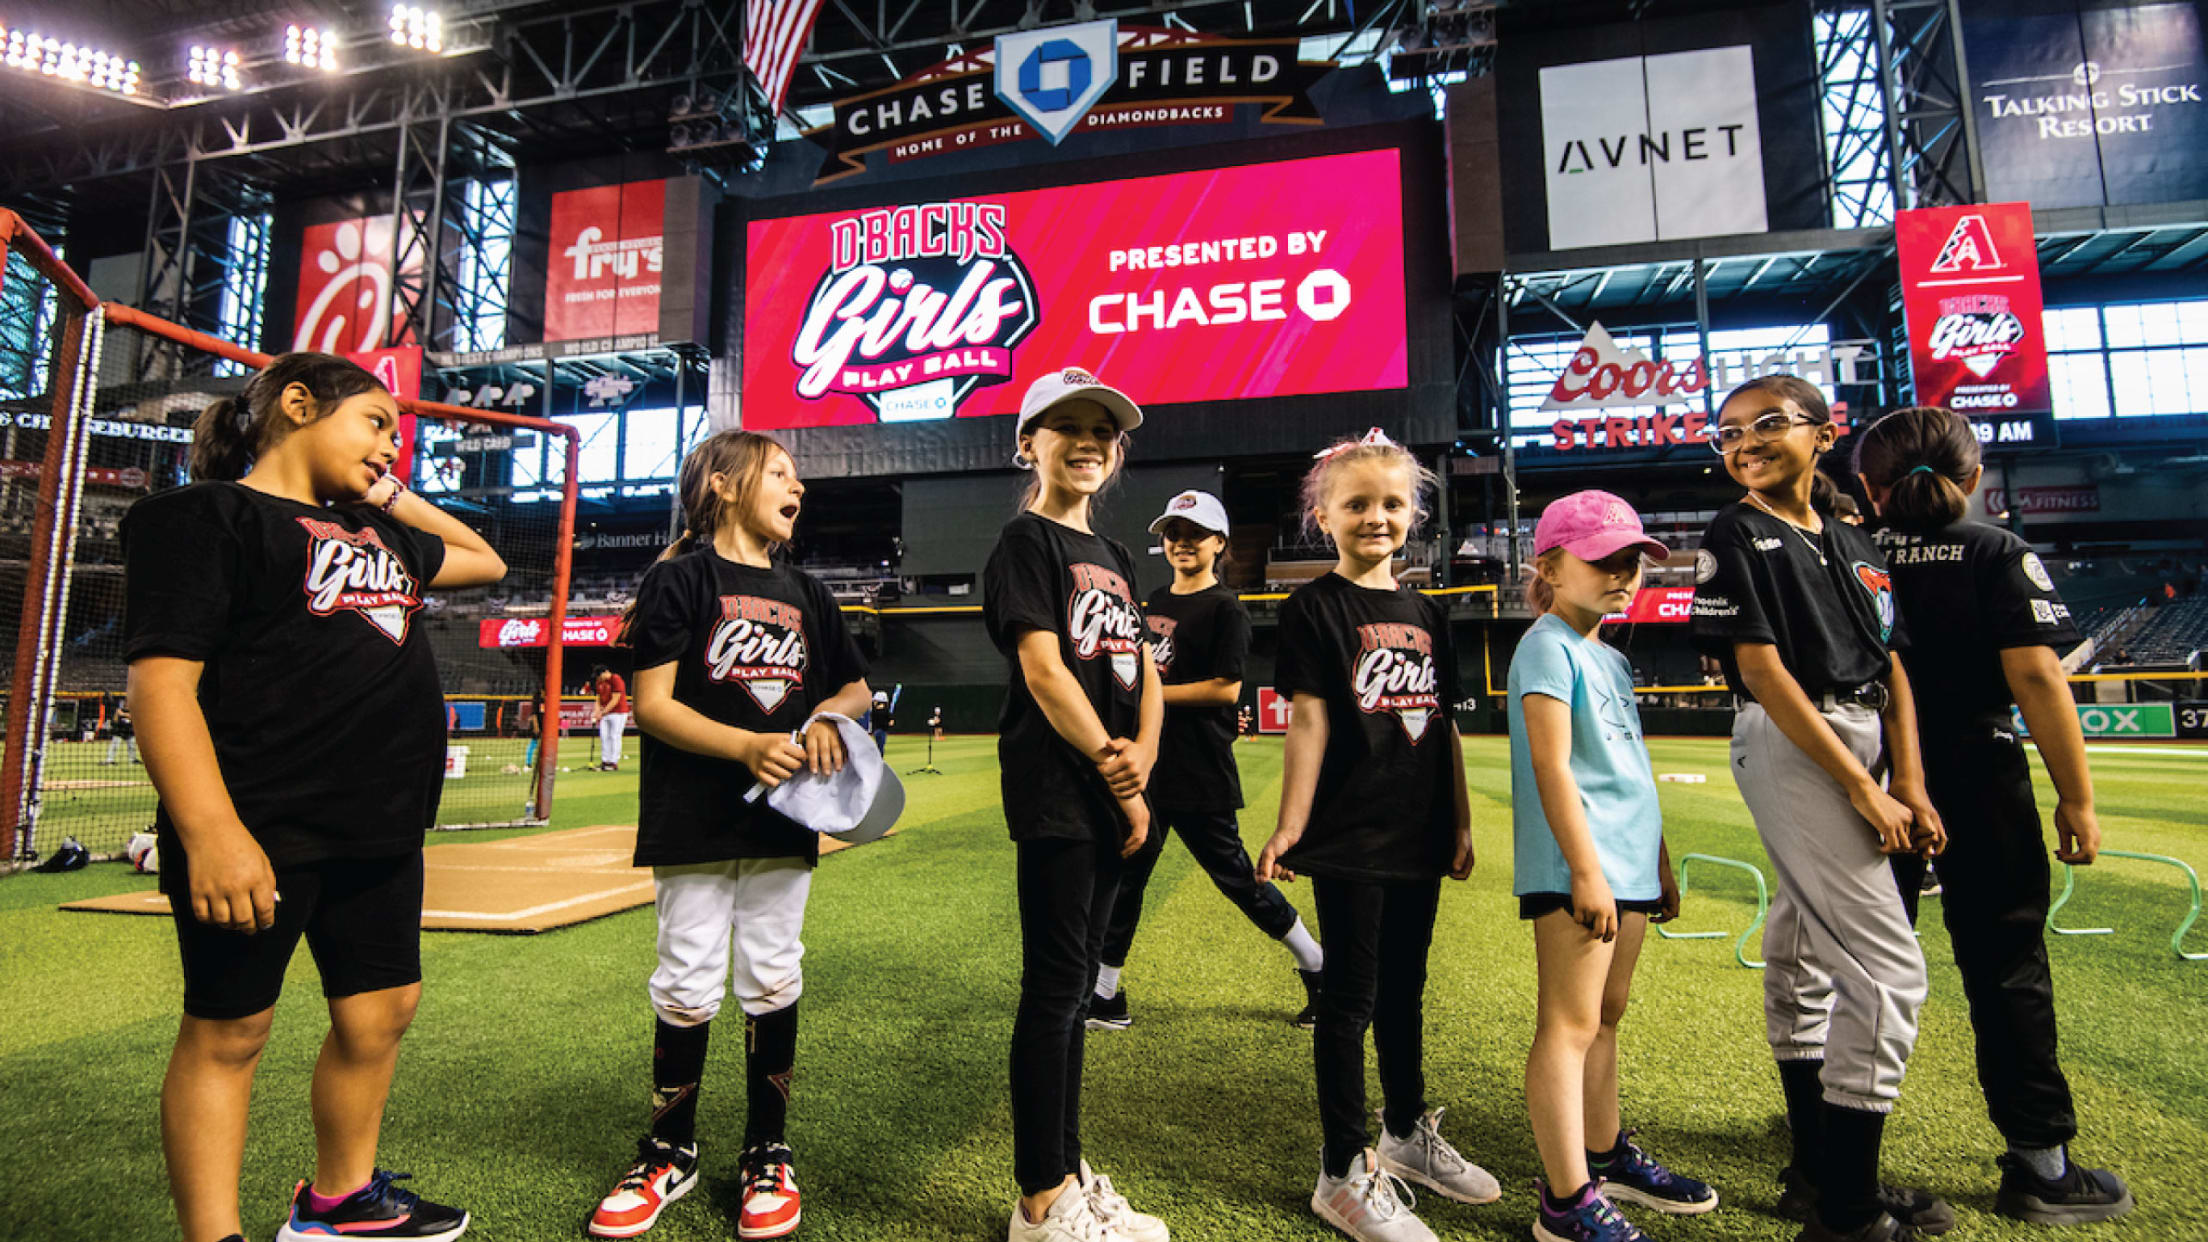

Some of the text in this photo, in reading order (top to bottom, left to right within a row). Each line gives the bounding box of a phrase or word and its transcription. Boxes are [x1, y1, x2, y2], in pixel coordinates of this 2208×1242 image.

[847, 54, 1279, 135] CHASE FIELD
[1983, 84, 2201, 118] TALKING STICK
[896, 107, 1224, 158] HOME OF THE DIAMONDBACKS
[2037, 114, 2154, 139] RESORT
[1558, 124, 1744, 174] AVNET
[1109, 230, 1327, 271] PRESENTED BY
[596, 289, 616, 300] FOR
[1089, 279, 1287, 334] CHASE
[793, 260, 1023, 397] Girls
[1930, 313, 2018, 360] Girls
[842, 350, 998, 388] PLAY BALL
[1551, 346, 1711, 402] Coors
[1950, 394, 2003, 409] CHASE
[1551, 412, 1709, 450] STRIKE
[1997, 420, 2033, 442] AM
[597, 533, 652, 548] Banner
[1895, 545, 1966, 565] RANCH
[562, 629, 596, 641] HASE
[708, 618, 806, 680] Girls
[731, 667, 767, 677] PLAY
